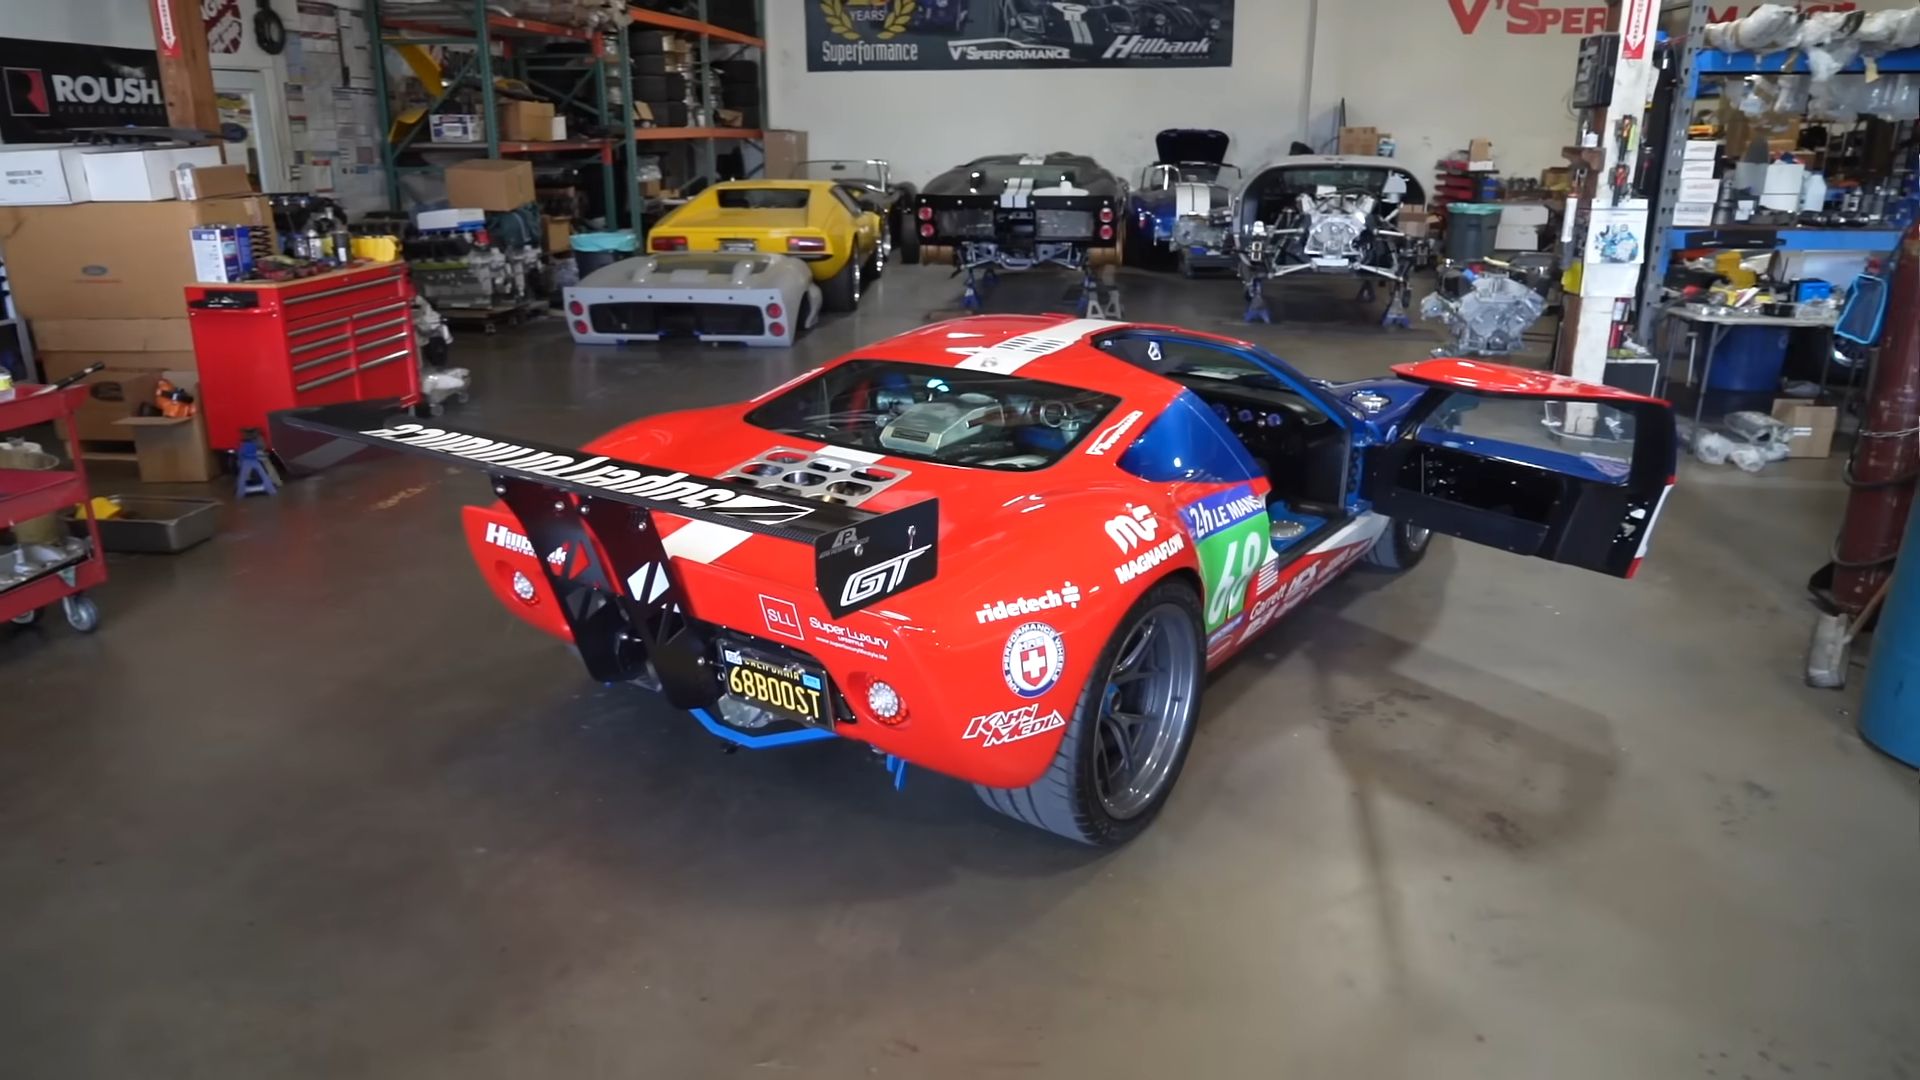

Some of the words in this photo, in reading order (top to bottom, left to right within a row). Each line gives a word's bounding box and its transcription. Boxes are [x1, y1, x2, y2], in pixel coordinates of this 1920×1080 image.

[851, 9, 885, 21] YEARS
[822, 40, 918, 65] Superformance
[1101, 34, 1211, 59] Hillbank
[51, 74, 162, 105] ROUSH
[1212, 508, 1231, 528] LE
[1114, 532, 1185, 585] MAGNAFLOW
[840, 543, 933, 607] GT
[1207, 531, 1262, 625] 68
[767, 608, 797, 627] SLL
[975, 589, 1063, 625] ridetech
